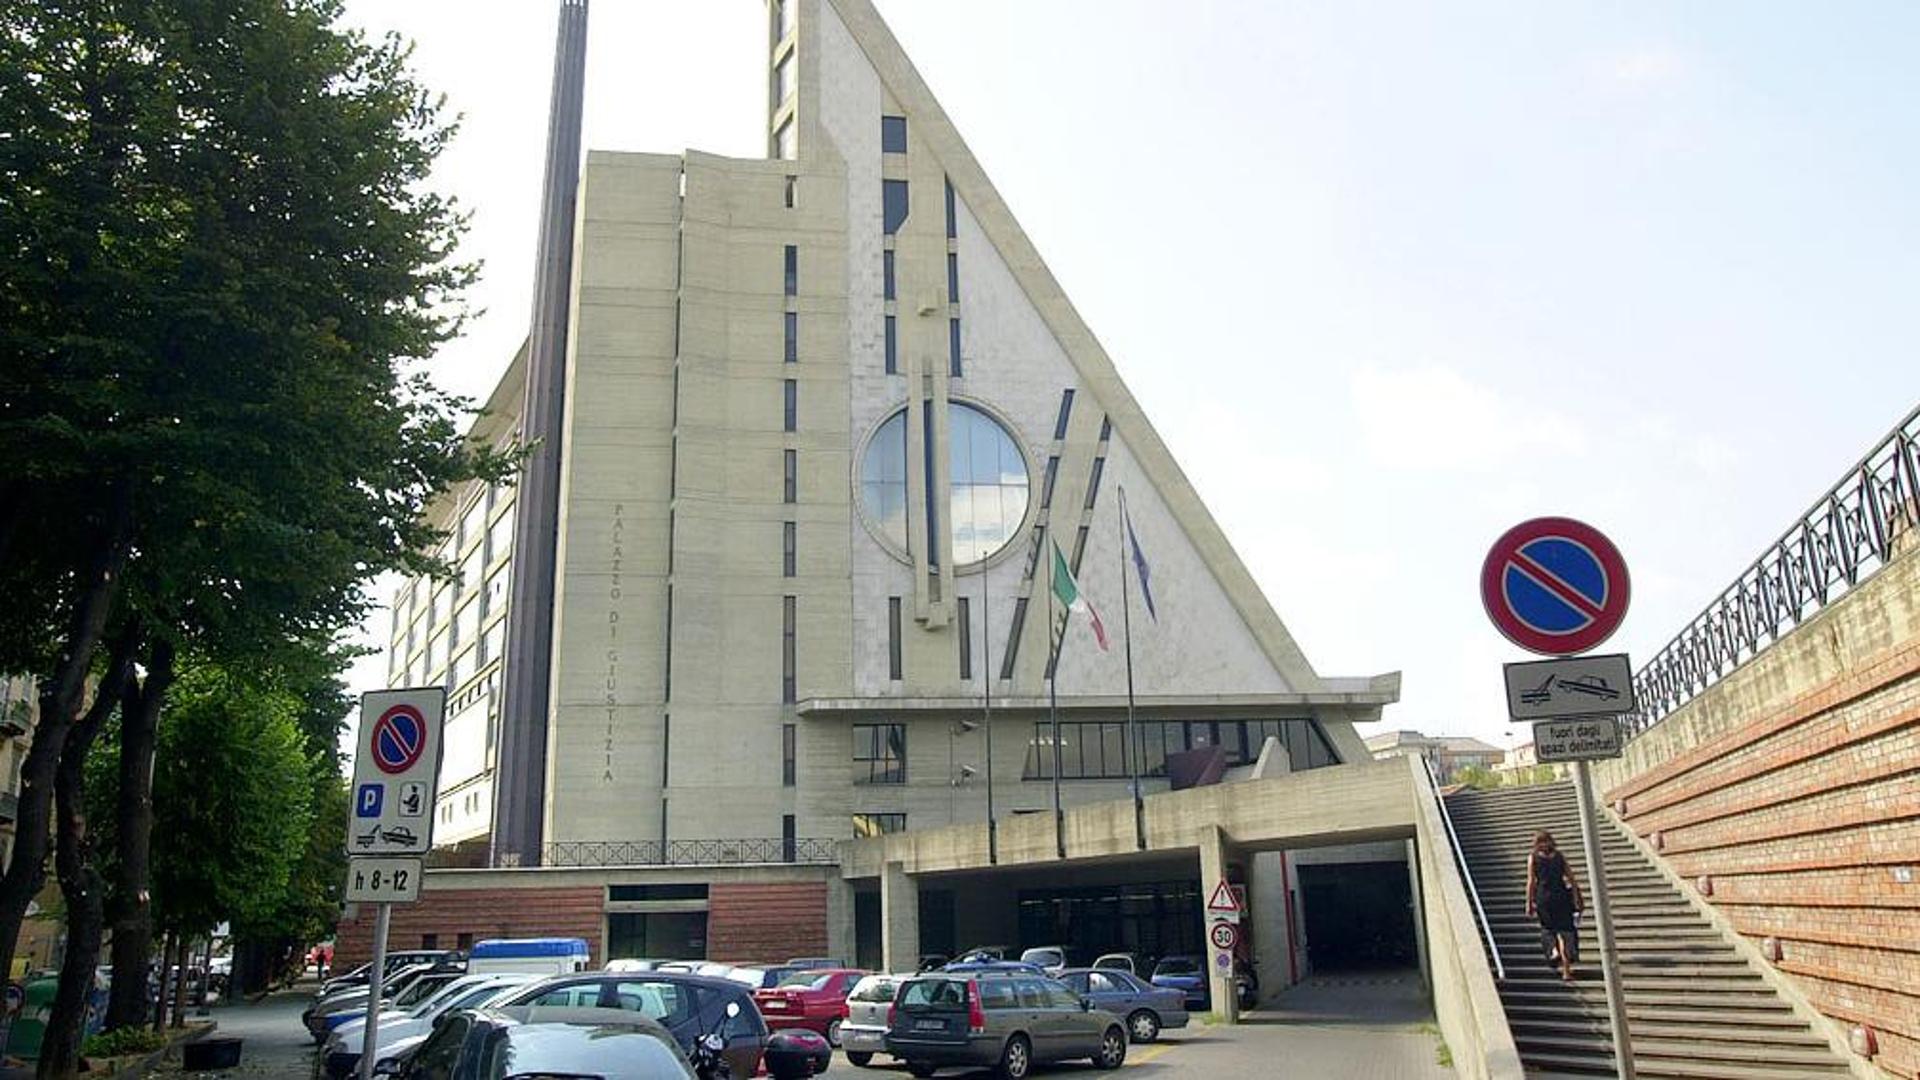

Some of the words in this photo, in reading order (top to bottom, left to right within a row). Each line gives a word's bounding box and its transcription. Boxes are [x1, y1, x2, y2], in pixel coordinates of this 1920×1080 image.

[610, 503, 624, 600] PALAZZO
[608, 610, 619, 638] DI
[602, 649, 618, 781] GIUSTIZIA
[1550, 727, 1573, 739] fuori
[1540, 744, 1566, 755] spazi
[1569, 737, 1615, 753] delimitati
[364, 790, 377, 810] P
[356, 871, 364, 890] h
[371, 870, 408, 891] 8-12
[1217, 930, 1231, 943] 30
